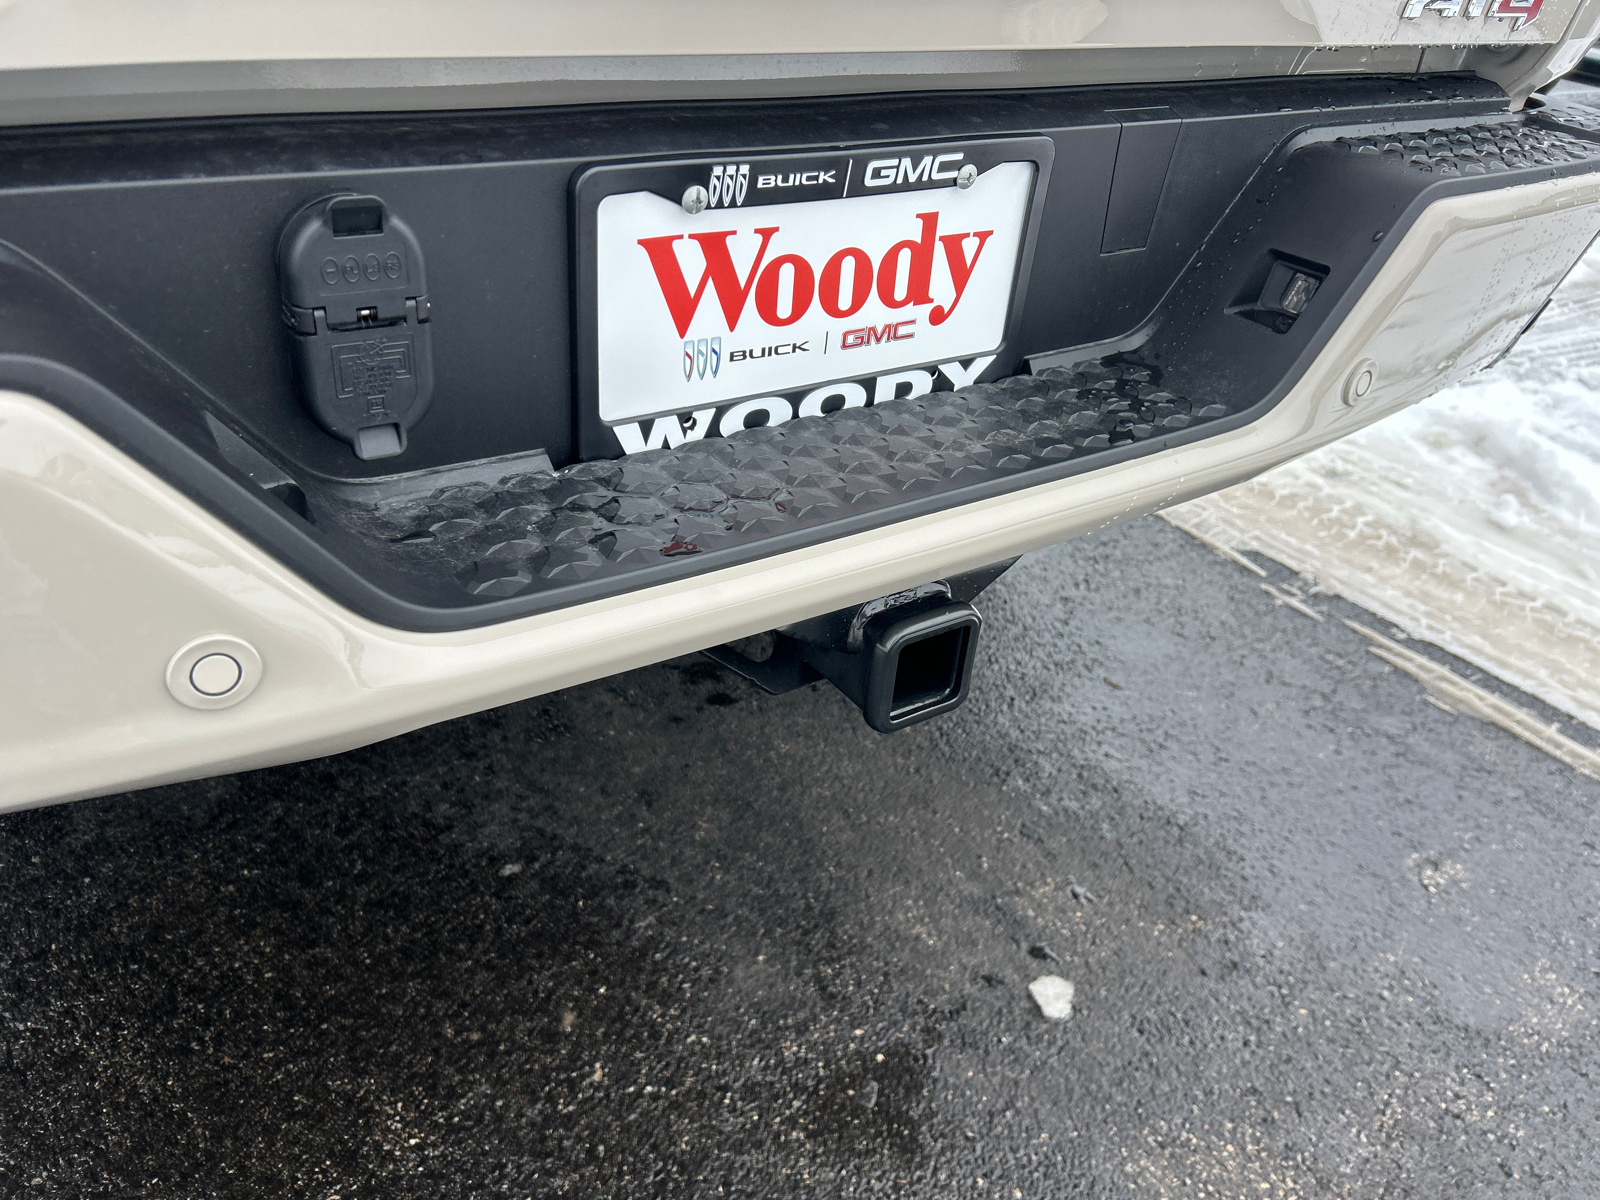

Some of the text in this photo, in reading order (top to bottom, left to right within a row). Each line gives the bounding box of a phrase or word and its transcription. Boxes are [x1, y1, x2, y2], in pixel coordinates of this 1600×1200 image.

[757, 152, 964, 188] BUICK GMC
[637, 211, 994, 339] Woody
[729, 318, 917, 362] BUICK GMC
